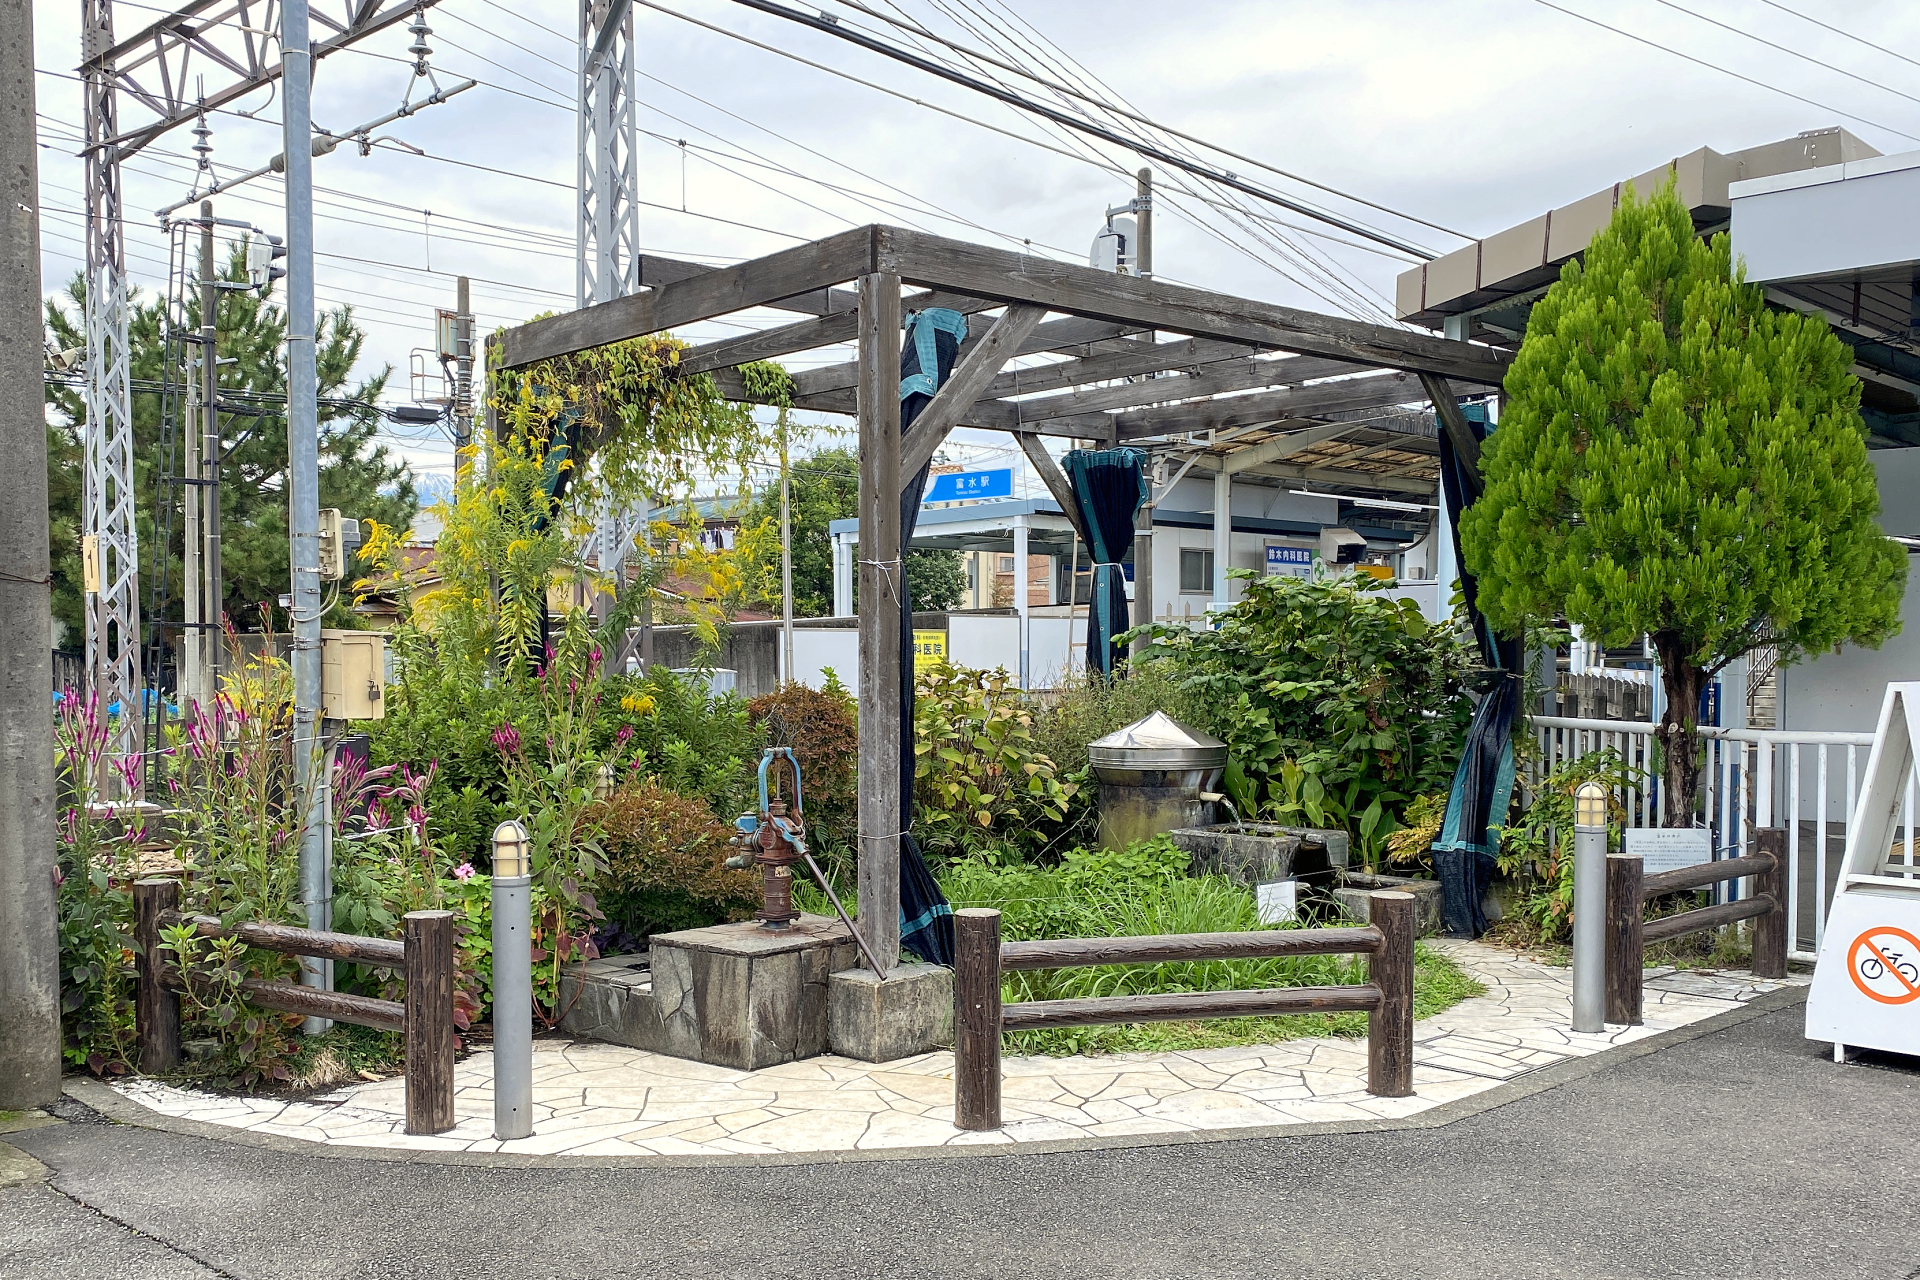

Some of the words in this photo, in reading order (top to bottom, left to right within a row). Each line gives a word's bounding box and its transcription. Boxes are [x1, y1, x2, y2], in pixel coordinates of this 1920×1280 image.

[956, 475, 989, 489] 富水駅
[1268, 548, 1310, 563] 鈴木内科医院
